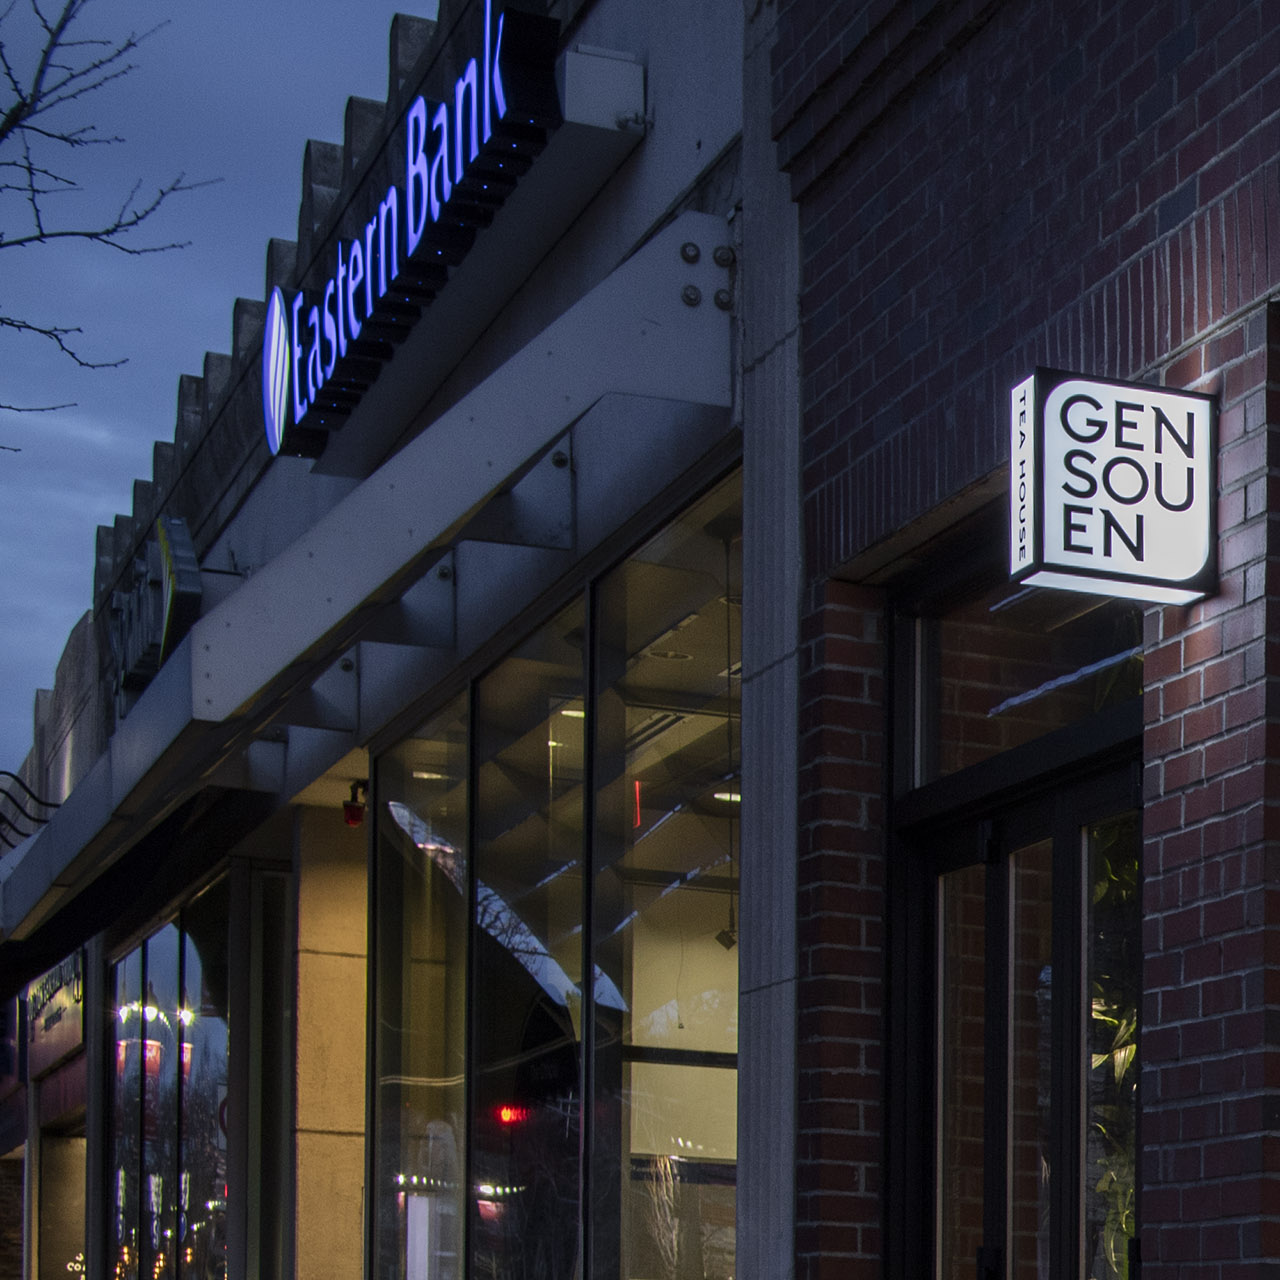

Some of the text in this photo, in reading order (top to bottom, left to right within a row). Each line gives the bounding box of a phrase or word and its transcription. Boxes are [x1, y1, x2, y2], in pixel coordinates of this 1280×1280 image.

[292, 0, 507, 425] Eastern Bank
[1059, 393, 1195, 460] GEN
[1018, 389, 1027, 563] TEA HOUSE
[1061, 448, 1195, 512] SOU
[1063, 502, 1145, 563] EN
